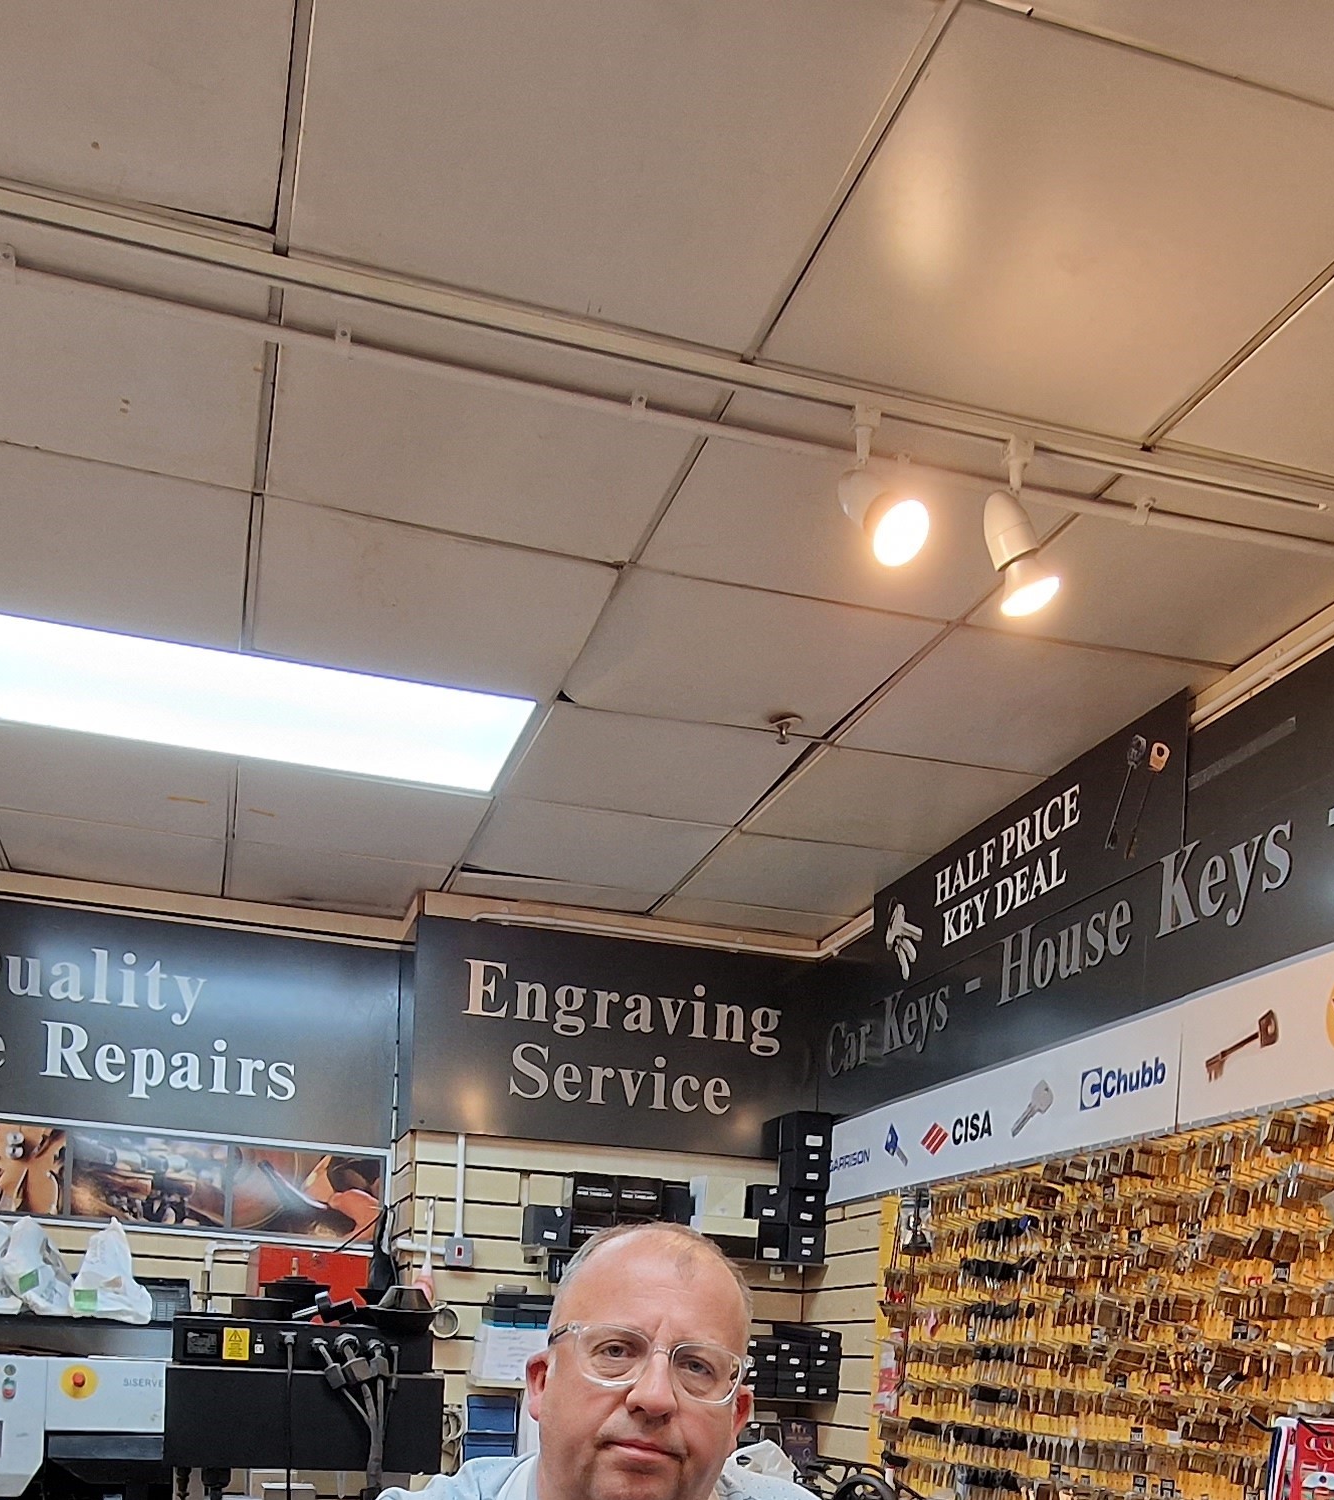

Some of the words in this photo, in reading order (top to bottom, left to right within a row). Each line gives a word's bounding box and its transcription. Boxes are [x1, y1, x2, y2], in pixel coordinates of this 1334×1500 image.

[934, 835, 997, 907] HALF
[1001, 784, 1080, 871] PRICE
[942, 894, 988, 948] KEY
[993, 847, 1067, 925] DEAL
[826, 1018, 871, 1078] Car
[882, 980, 950, 1057] Keys
[997, 897, 1132, 1007] House
[1156, 819, 1293, 940] Keys
[462, 957, 783, 1057] Engraving
[42, 1020, 298, 1103] Repairs
[508, 1043, 733, 1117] Service
[1102, 1056, 1166, 1099] Chubb
[830, 1148, 871, 1173] GARRISON
[952, 1110, 993, 1146] CISA
